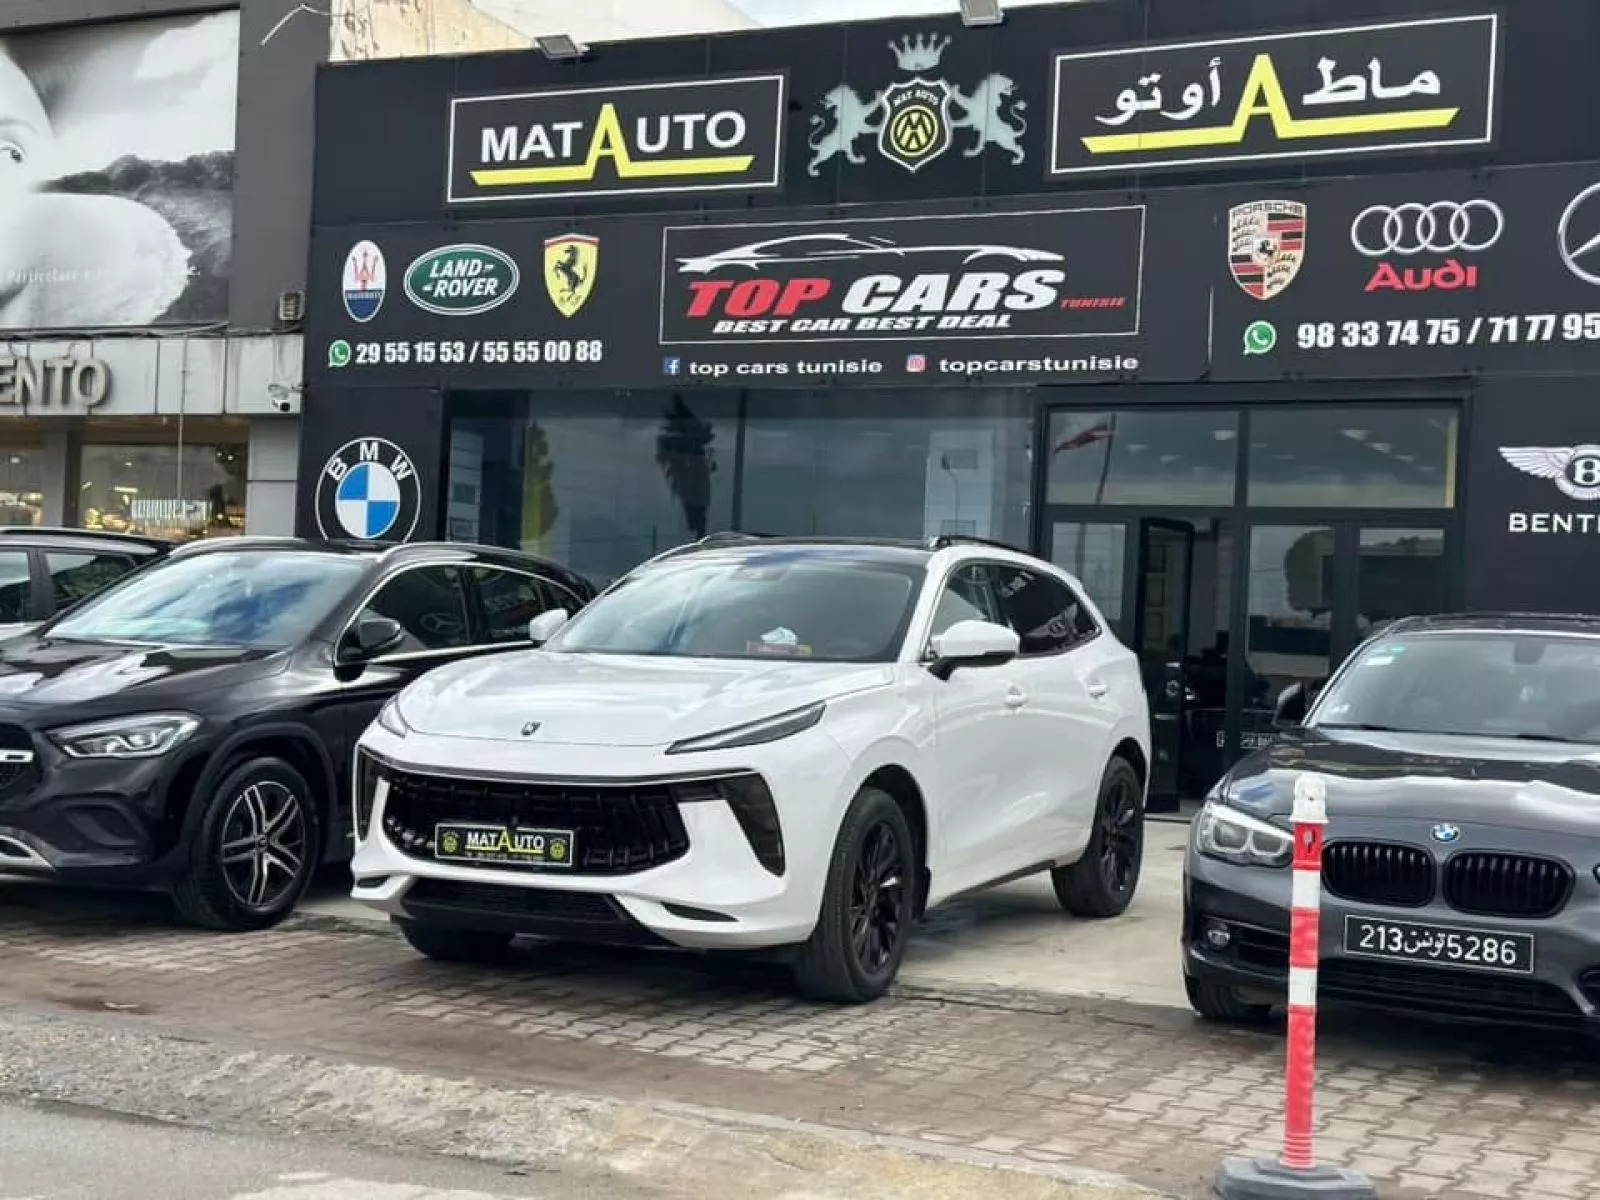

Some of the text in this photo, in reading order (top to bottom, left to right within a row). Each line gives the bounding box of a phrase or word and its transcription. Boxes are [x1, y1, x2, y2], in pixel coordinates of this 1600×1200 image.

[1302, 57, 1440, 106] ماط
[1364, 258, 1478, 292] Audi
[685, 278, 832, 318] TOP
[841, 269, 1066, 316] CARS
[712, 313, 1012, 334] BEST CAR BEST DEAL
[1297, 322, 1336, 349] 98
[1341, 320, 1380, 348] 33
[1386, 318, 1420, 346] 74
[1425, 318, 1461, 345] 75
[1487, 315, 1518, 343] 71
[1524, 314, 1556, 341] 77
[1562, 311, 1600, 340] 95
[355, 342, 381, 364] 29
[384, 341, 411, 363] 55
[413, 341, 436, 363] 15
[439, 341, 466, 363] 53
[482, 340, 510, 363] 55
[513, 341, 539, 362] 55
[544, 340, 571, 362] 00
[575, 339, 603, 362] 88
[689, 360, 729, 378] top
[735, 361, 789, 375] cars
[797, 358, 883, 374] tunisie
[938, 354, 1139, 373] topcarstunisie
[326, 440, 413, 482] BMW
[1508, 512, 1600, 533] BENT
[1359, 924, 1403, 952] 213
[1447, 934, 1517, 965] 5286
